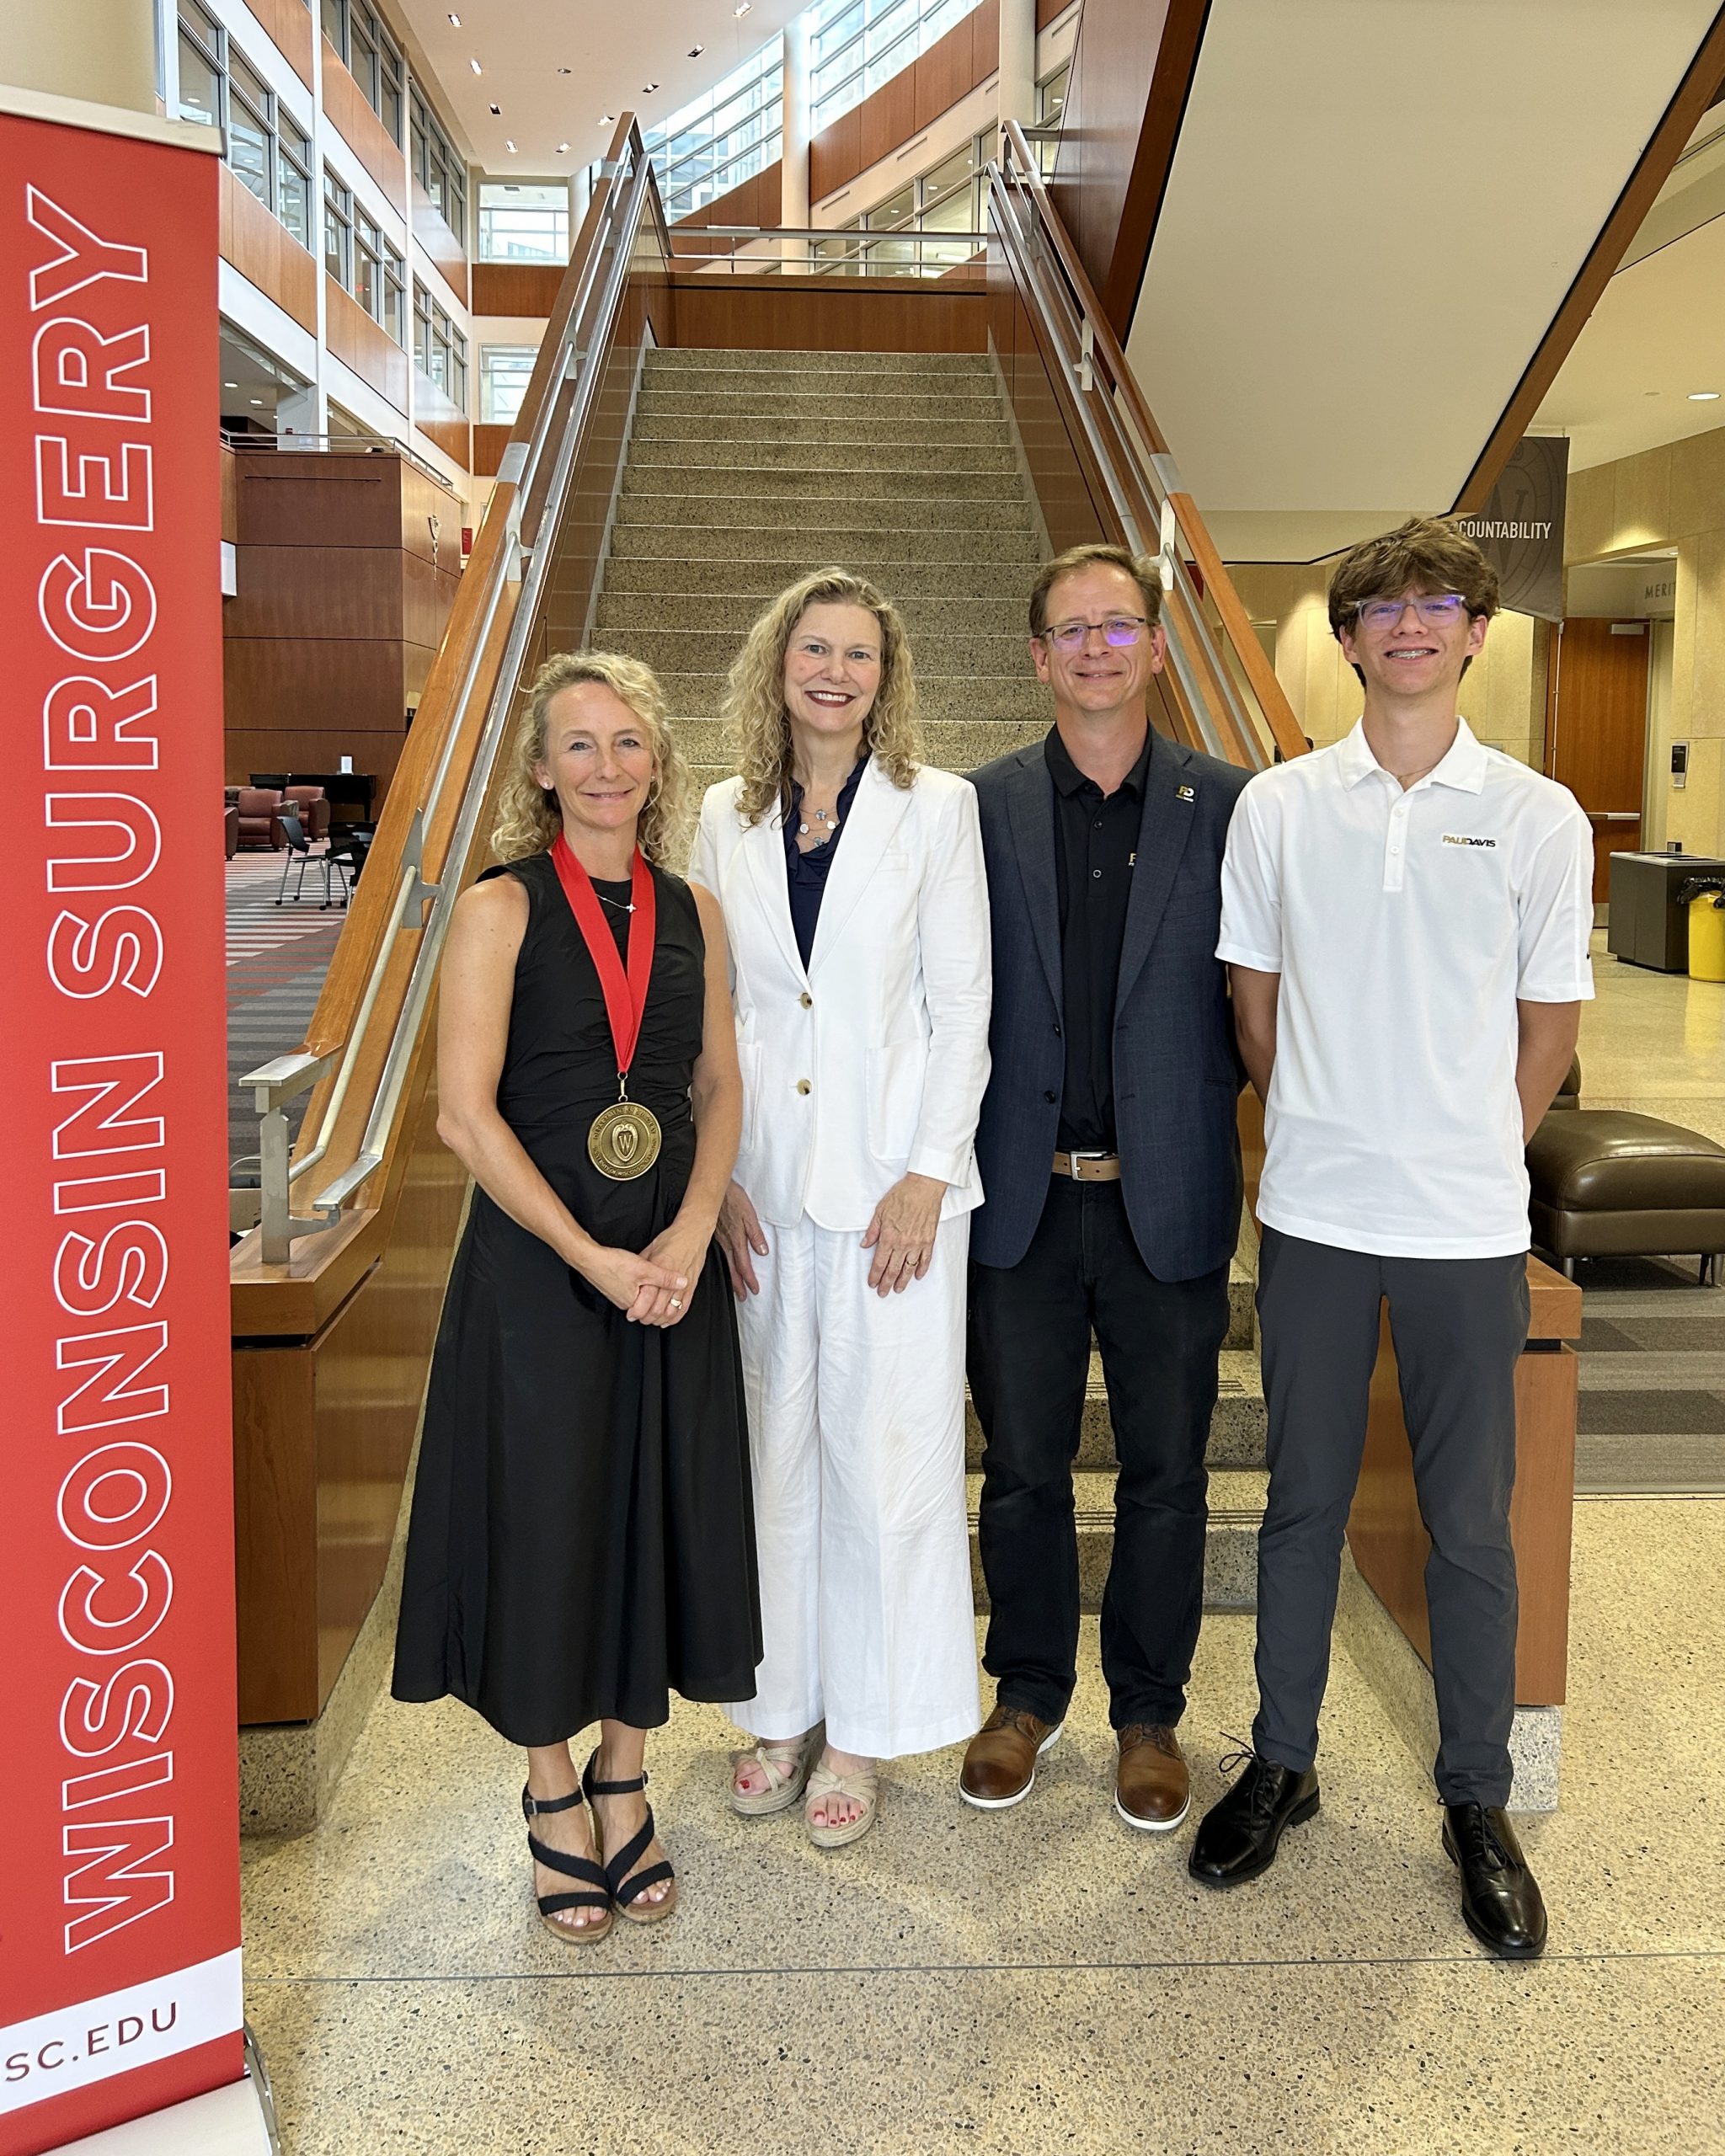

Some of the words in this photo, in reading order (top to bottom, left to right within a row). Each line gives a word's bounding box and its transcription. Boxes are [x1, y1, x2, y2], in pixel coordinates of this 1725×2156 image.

[27, 182, 163, 999] SURGERY
[51, 1050, 174, 1955] WISCONSIN
[4, 2001, 178, 2083] SC.EDU
